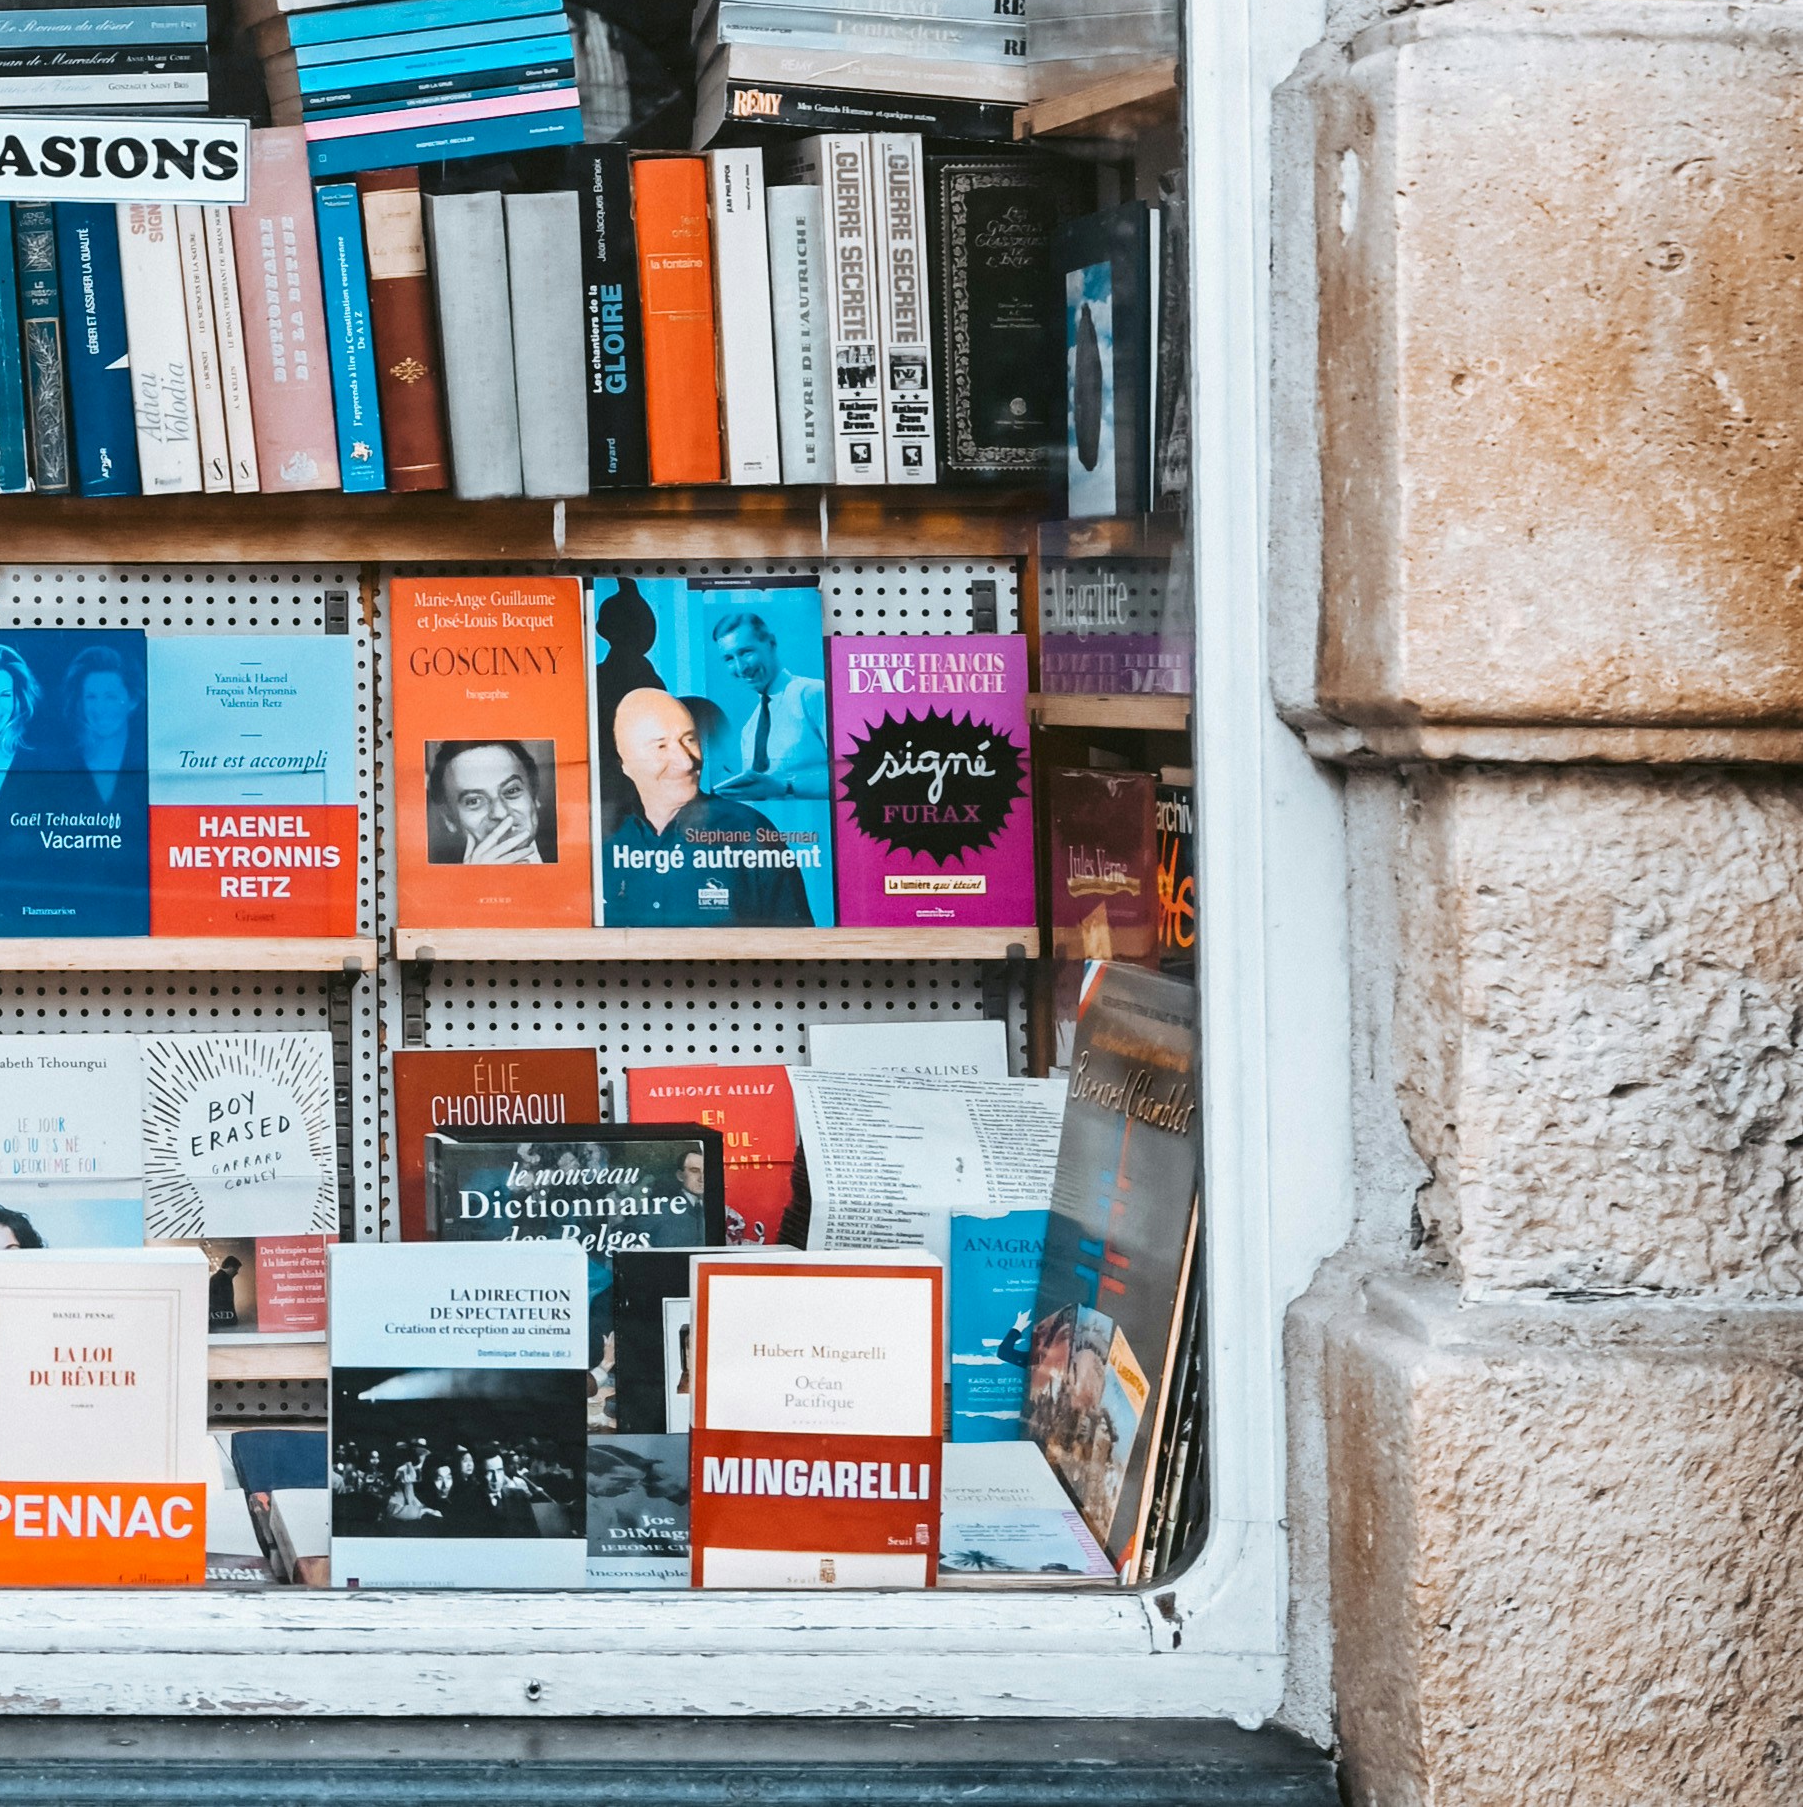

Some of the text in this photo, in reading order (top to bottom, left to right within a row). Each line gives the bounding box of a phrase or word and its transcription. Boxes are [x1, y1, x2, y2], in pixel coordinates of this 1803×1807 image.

[835, 152, 867, 342] GUERRE SECRETE
[601, 284, 628, 394] GLOIRE
[796, 216, 816, 464] LE LIVRE DE L'AUTRICHE
[1049, 568, 1128, 643] Magritte
[410, 645, 563, 677] GOSCINNY
[848, 653, 914, 668] PIERRE
[919, 653, 1004, 672] FRANCIS
[848, 668, 915, 694] DAC
[919, 674, 1006, 694] BLANCHE
[867, 740, 996, 804] signé
[882, 804, 982, 823] FURAX
[199, 816, 310, 838] HAENEL
[40, 831, 122, 850] Vacarme
[169, 845, 341, 869] MEYRONNIS
[613, 844, 821, 874] Hergé autrement
[1068, 845, 1093, 881] Jules
[220, 876, 291, 898] RETZ
[474, 1058, 520, 1094] ÉLIE
[209, 1090, 254, 1123] BOY
[431, 1094, 565, 1126] CHOURAQUI
[191, 1115, 290, 1157] ERASED
[506, 1162, 640, 1187] le nouveau
[459, 1187, 687, 1219] Dictionnaire
[450, 1288, 571, 1303] LA DIRECTION
[430, 1307, 571, 1321] DE SPECTATEURS
[385, 1323, 571, 1337] Création et réception au cinéma
[54, 1347, 113, 1363] LA LOI
[753, 1344, 886, 1362] Hubert Mingarelli
[29, 1366, 136, 1387] DU RÊVEUR
[702, 1456, 931, 1501] MINGARELLI
